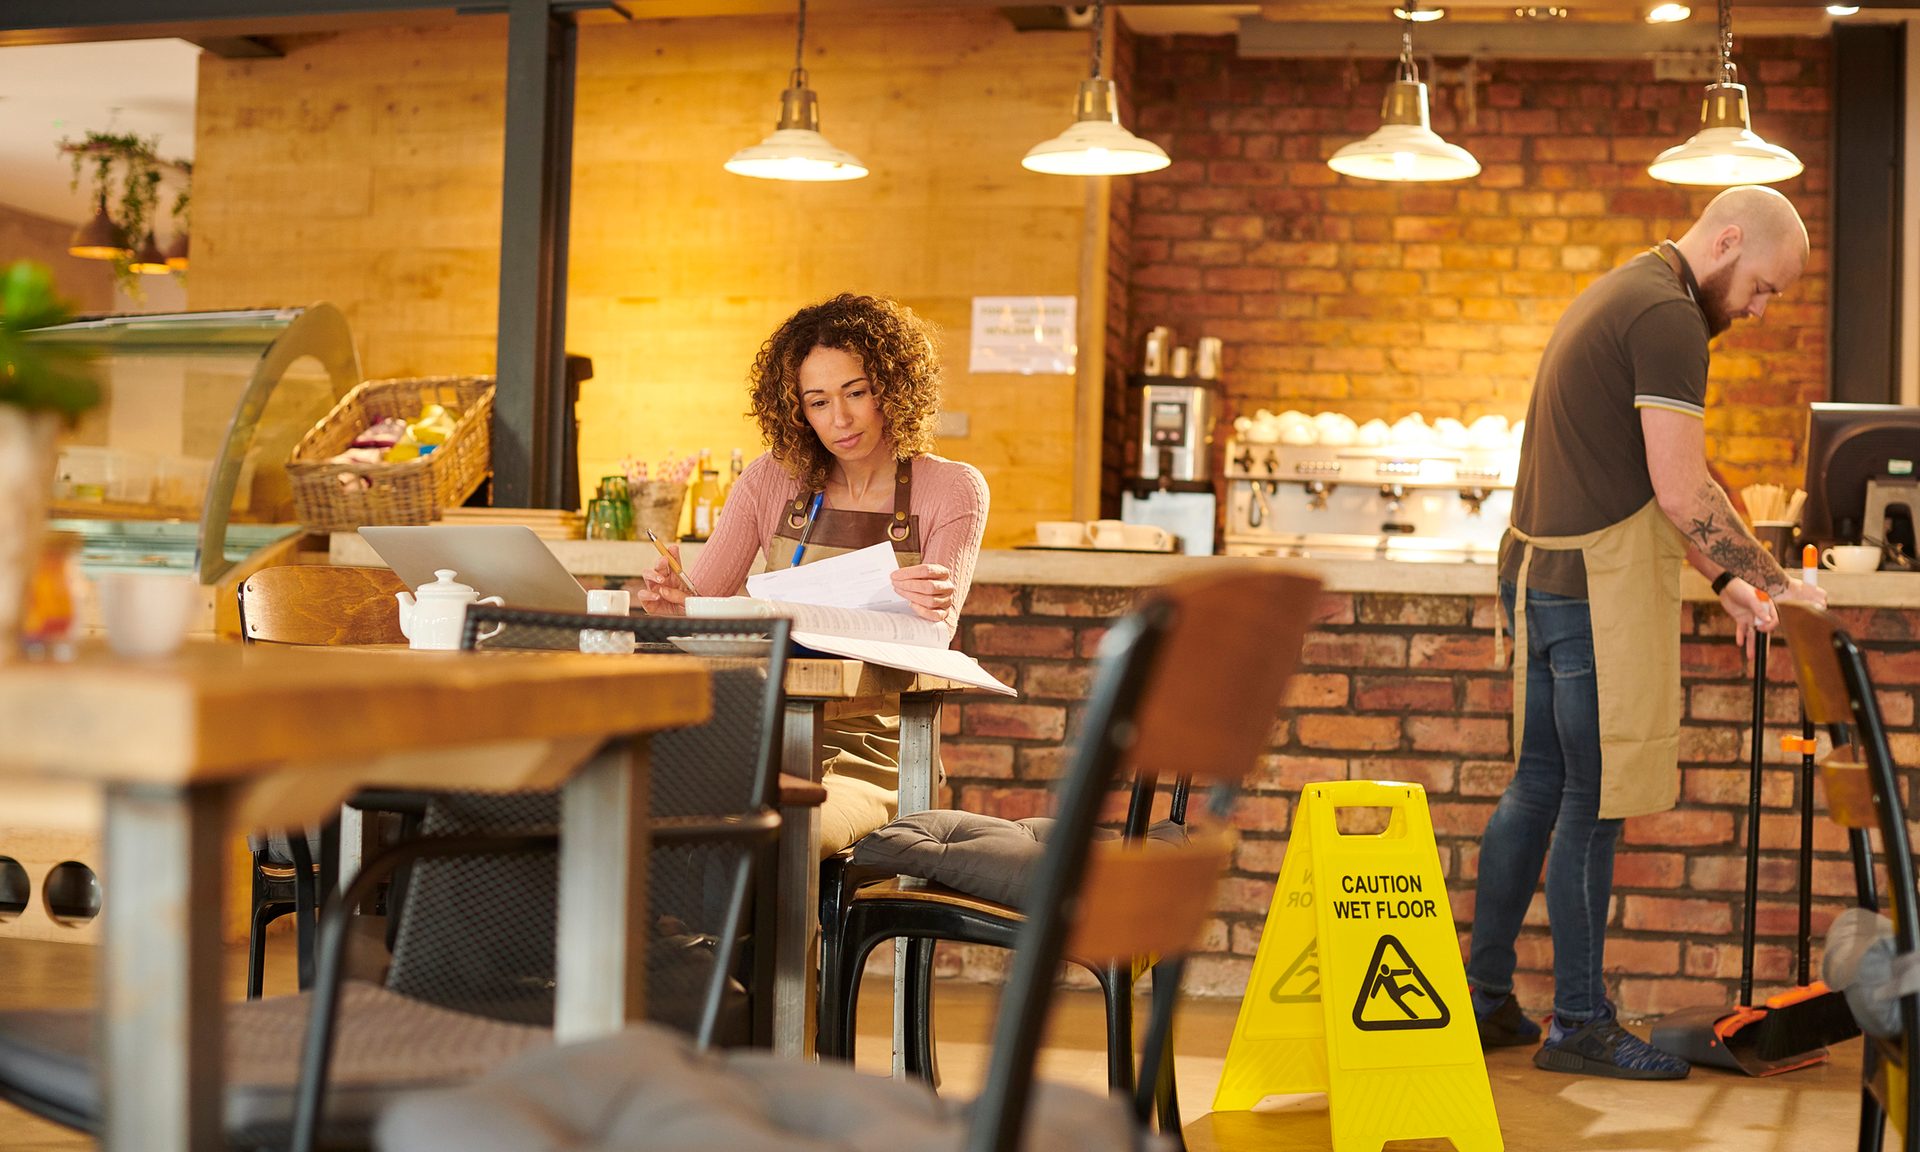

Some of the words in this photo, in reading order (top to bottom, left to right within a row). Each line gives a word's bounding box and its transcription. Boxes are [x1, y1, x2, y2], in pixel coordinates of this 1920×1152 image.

[1342, 875, 1423, 894] CAUTION
[1334, 901, 1371, 919] WET
[1377, 900, 1437, 919] FLOOR
